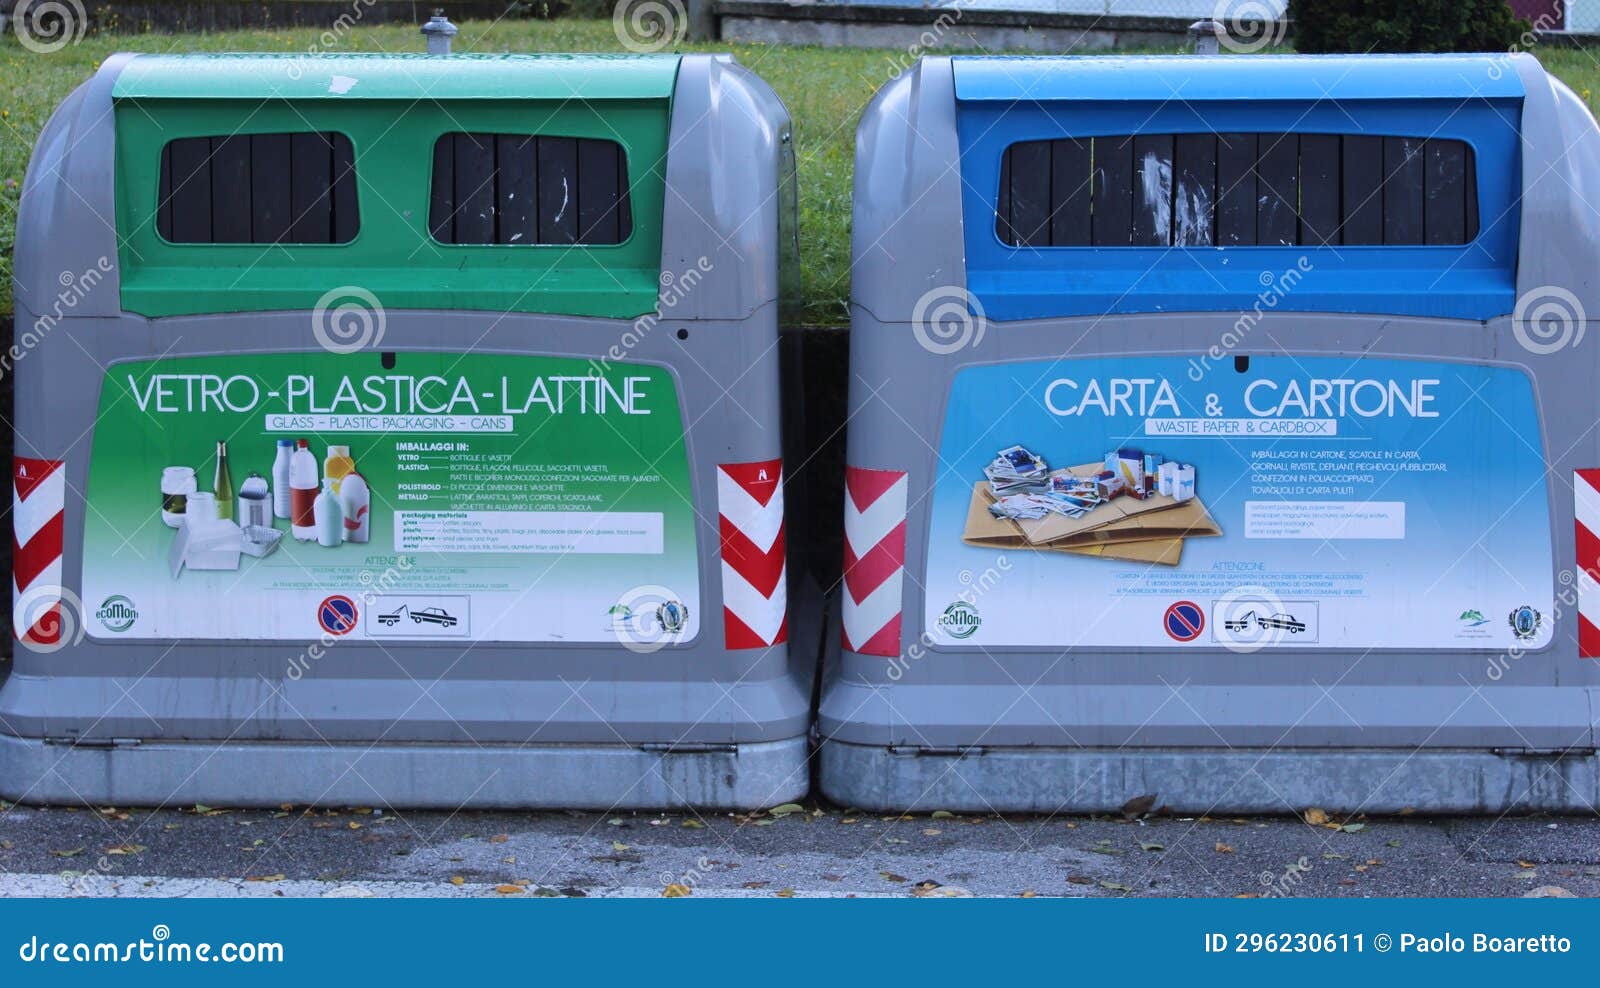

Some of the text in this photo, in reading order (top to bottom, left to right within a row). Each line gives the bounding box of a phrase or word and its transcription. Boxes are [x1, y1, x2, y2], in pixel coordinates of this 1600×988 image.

[128, 374, 259, 412] VETRO
[288, 375, 479, 414] PLASTICA
[502, 376, 651, 414] LATTINE
[1044, 378, 1440, 417] CARTA & CARTONE
[272, 417, 314, 429] GLASS
[330, 417, 379, 429] PLASTIC
[382, 417, 455, 430] PACKAGING
[471, 418, 506, 430] CANS
[1155, 420, 1327, 433] WASTE PAPER & CARDBOX
[396, 442, 469, 451] IMBALLAGGI IN:
[1300, 450, 1308, 459] IN
[1349, 450, 1381, 459] SCATOLE
[1384, 450, 1392, 459] IN
